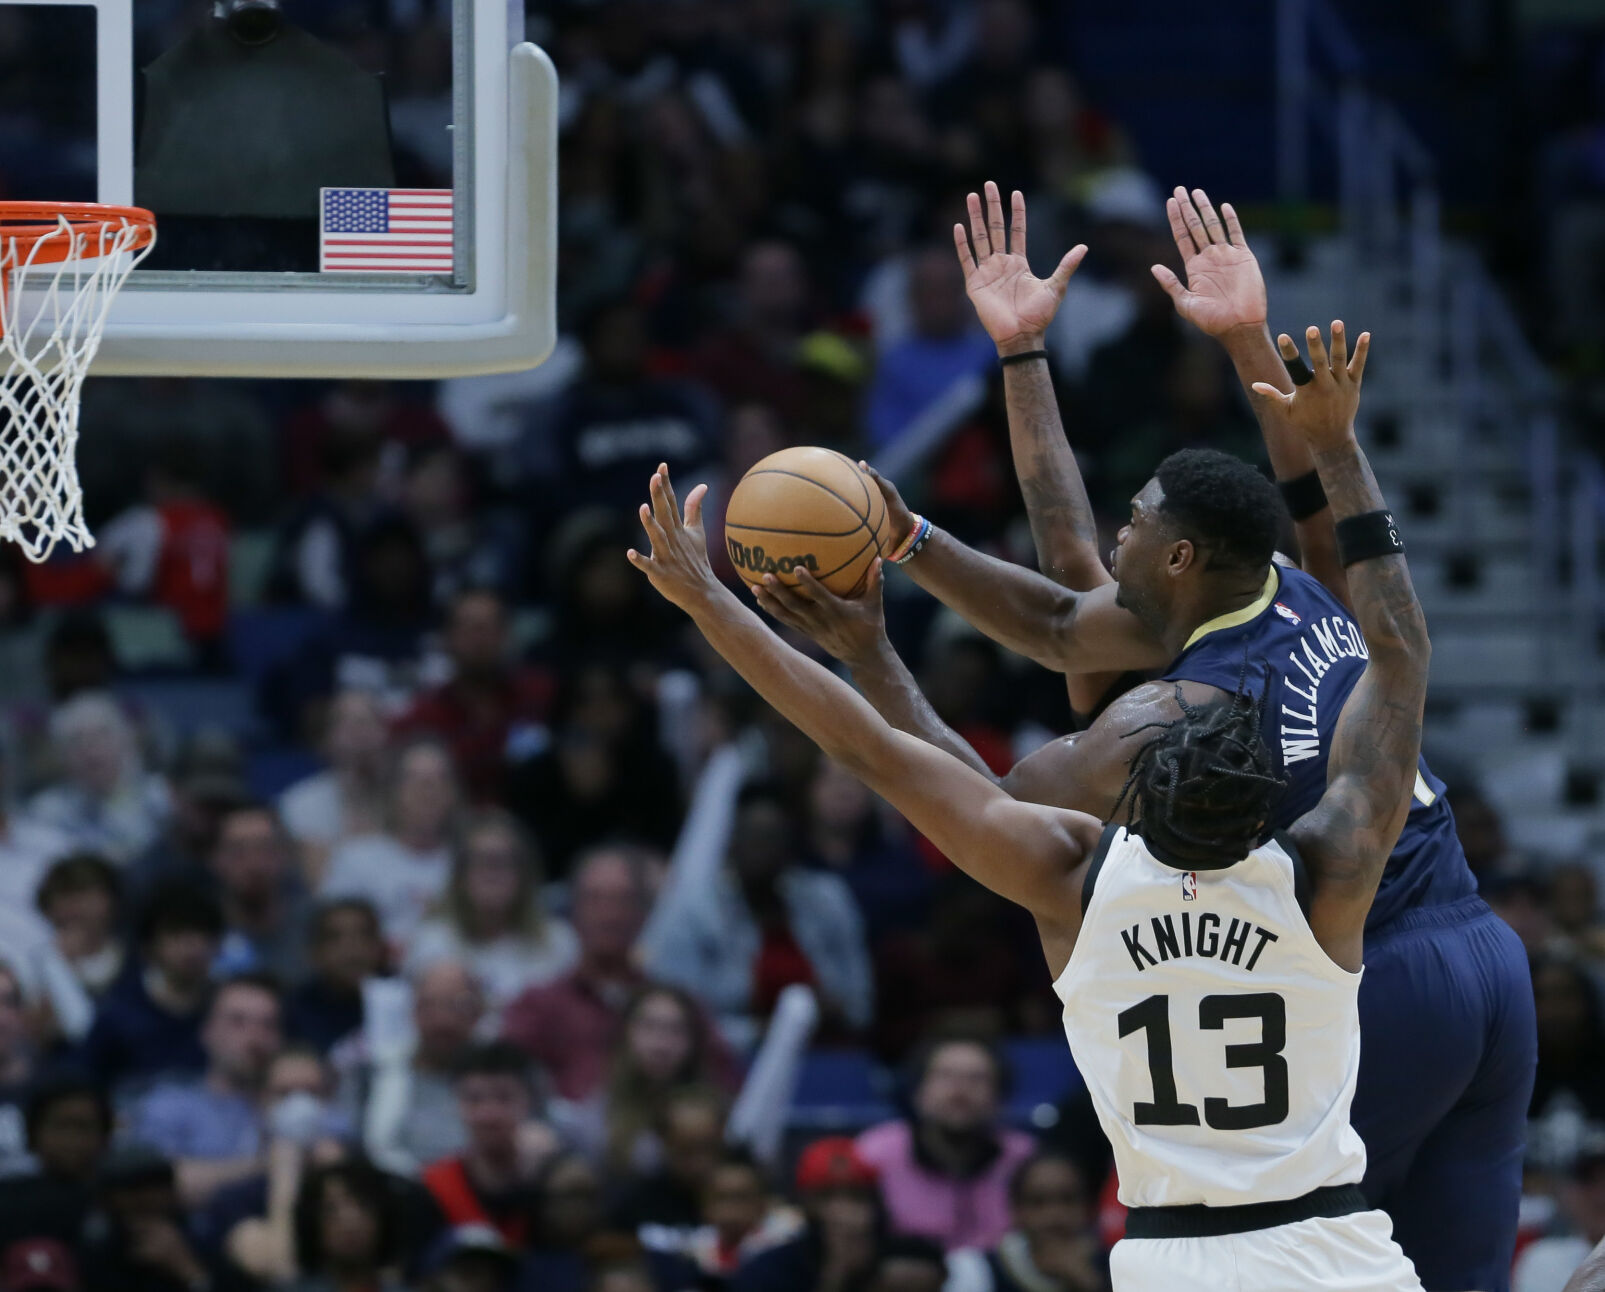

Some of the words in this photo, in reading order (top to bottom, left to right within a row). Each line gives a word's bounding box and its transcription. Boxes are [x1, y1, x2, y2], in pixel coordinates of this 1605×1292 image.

[728, 536, 820, 575] Wilson
[1281, 616, 1369, 767] WILLIAMSO
[1120, 912, 1279, 972] KNIGHT
[1117, 992, 1290, 1131] 13
